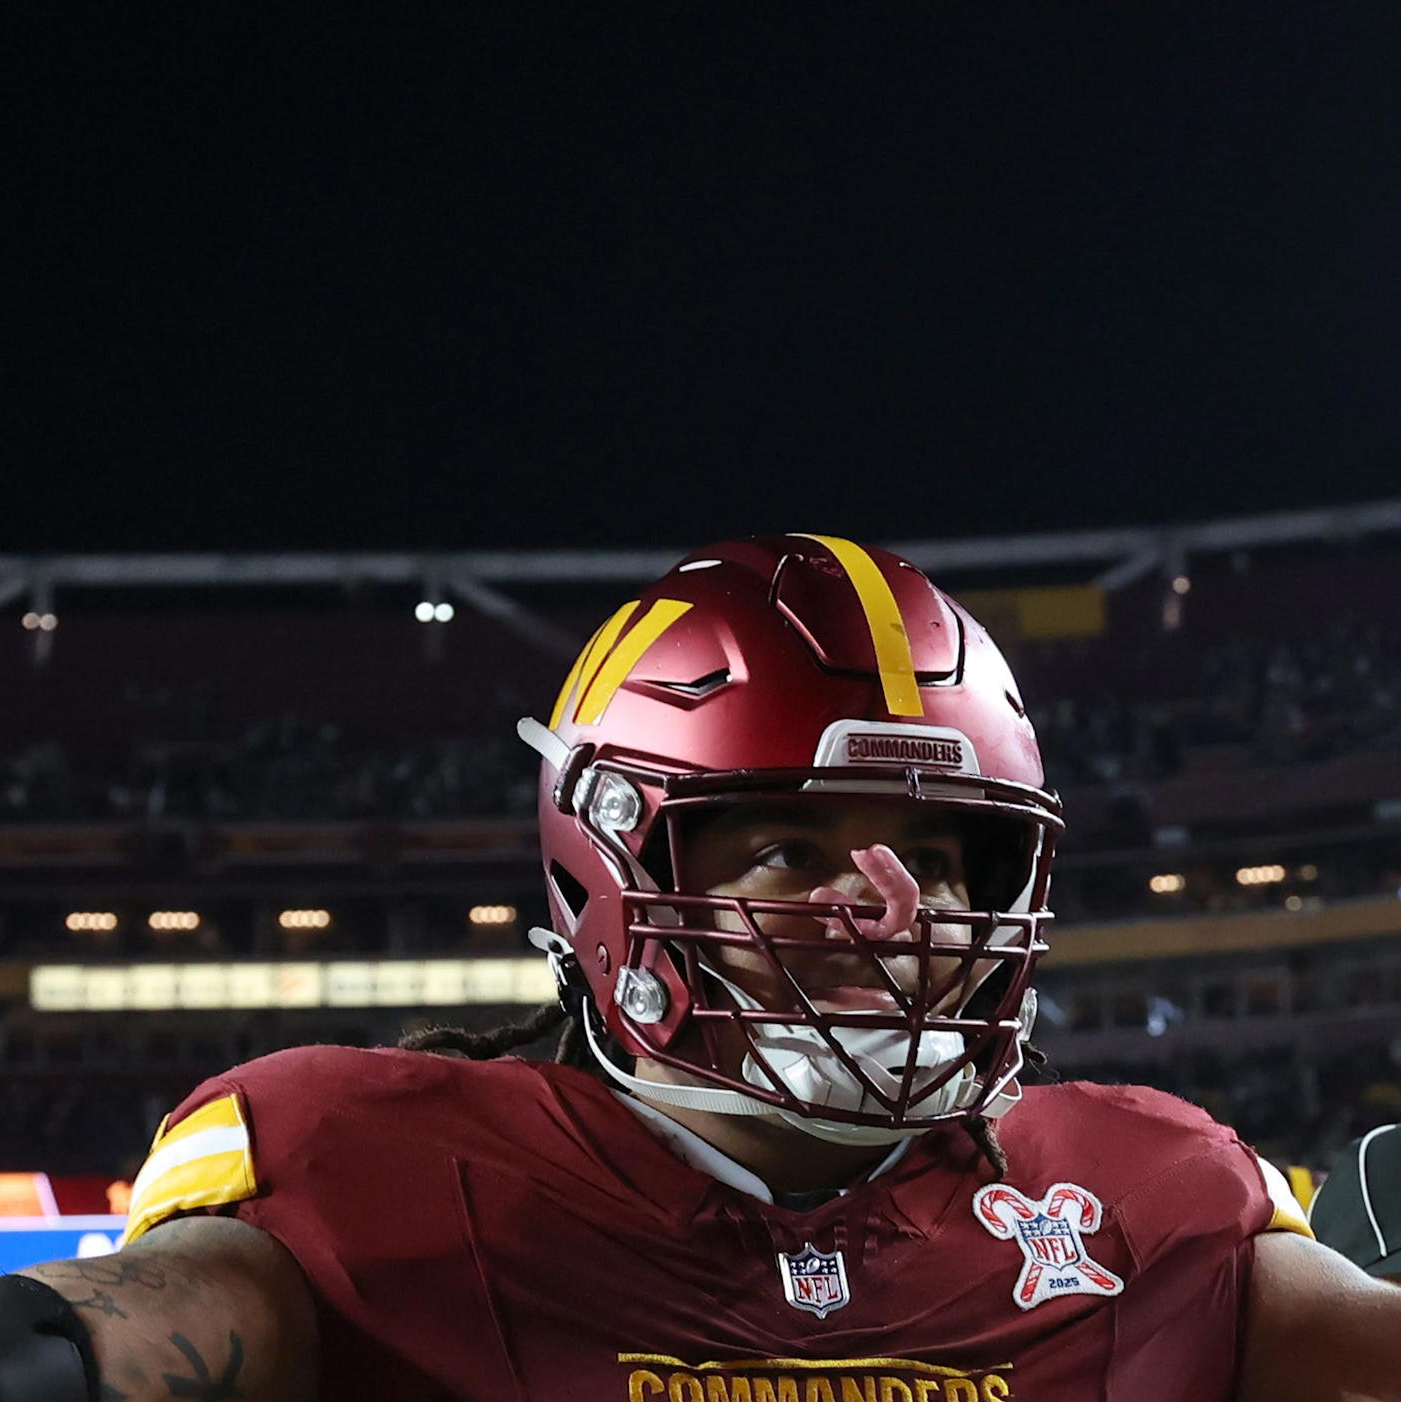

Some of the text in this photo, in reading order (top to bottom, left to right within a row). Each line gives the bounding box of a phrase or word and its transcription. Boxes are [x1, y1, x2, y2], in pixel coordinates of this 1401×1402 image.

[847, 738, 963, 764] COMMANDERS
[1029, 1237, 1076, 1264] NFL
[795, 1276, 839, 1303] NFL
[1049, 1278, 1080, 1289] 2025
